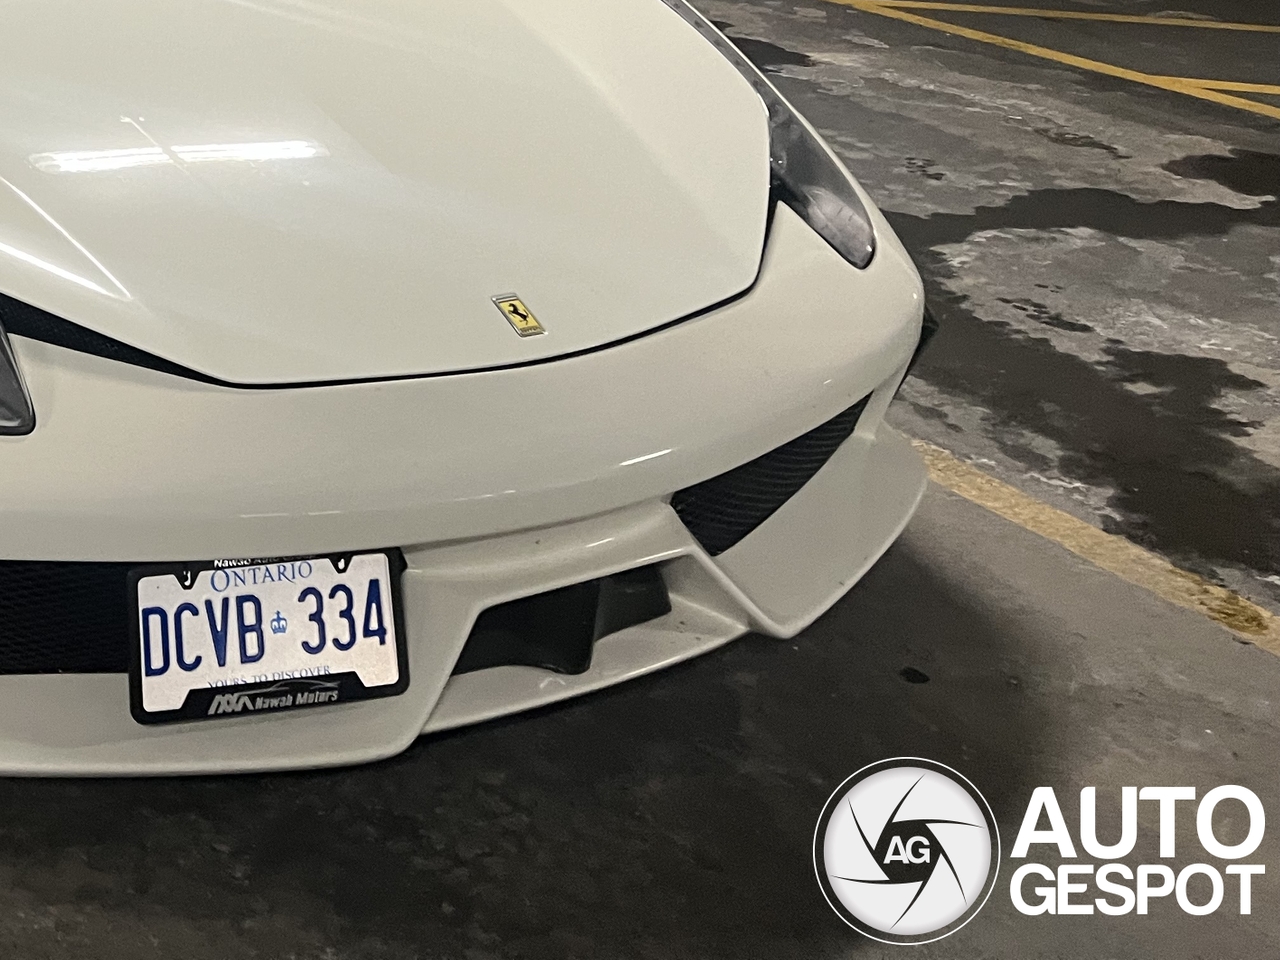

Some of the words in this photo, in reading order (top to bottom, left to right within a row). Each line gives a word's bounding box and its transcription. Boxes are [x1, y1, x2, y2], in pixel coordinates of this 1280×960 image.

[210, 559, 313, 592] ONTARIO
[141, 594, 266, 677] DCVB
[297, 579, 387, 655] 334
[295, 690, 339, 705] Motors
